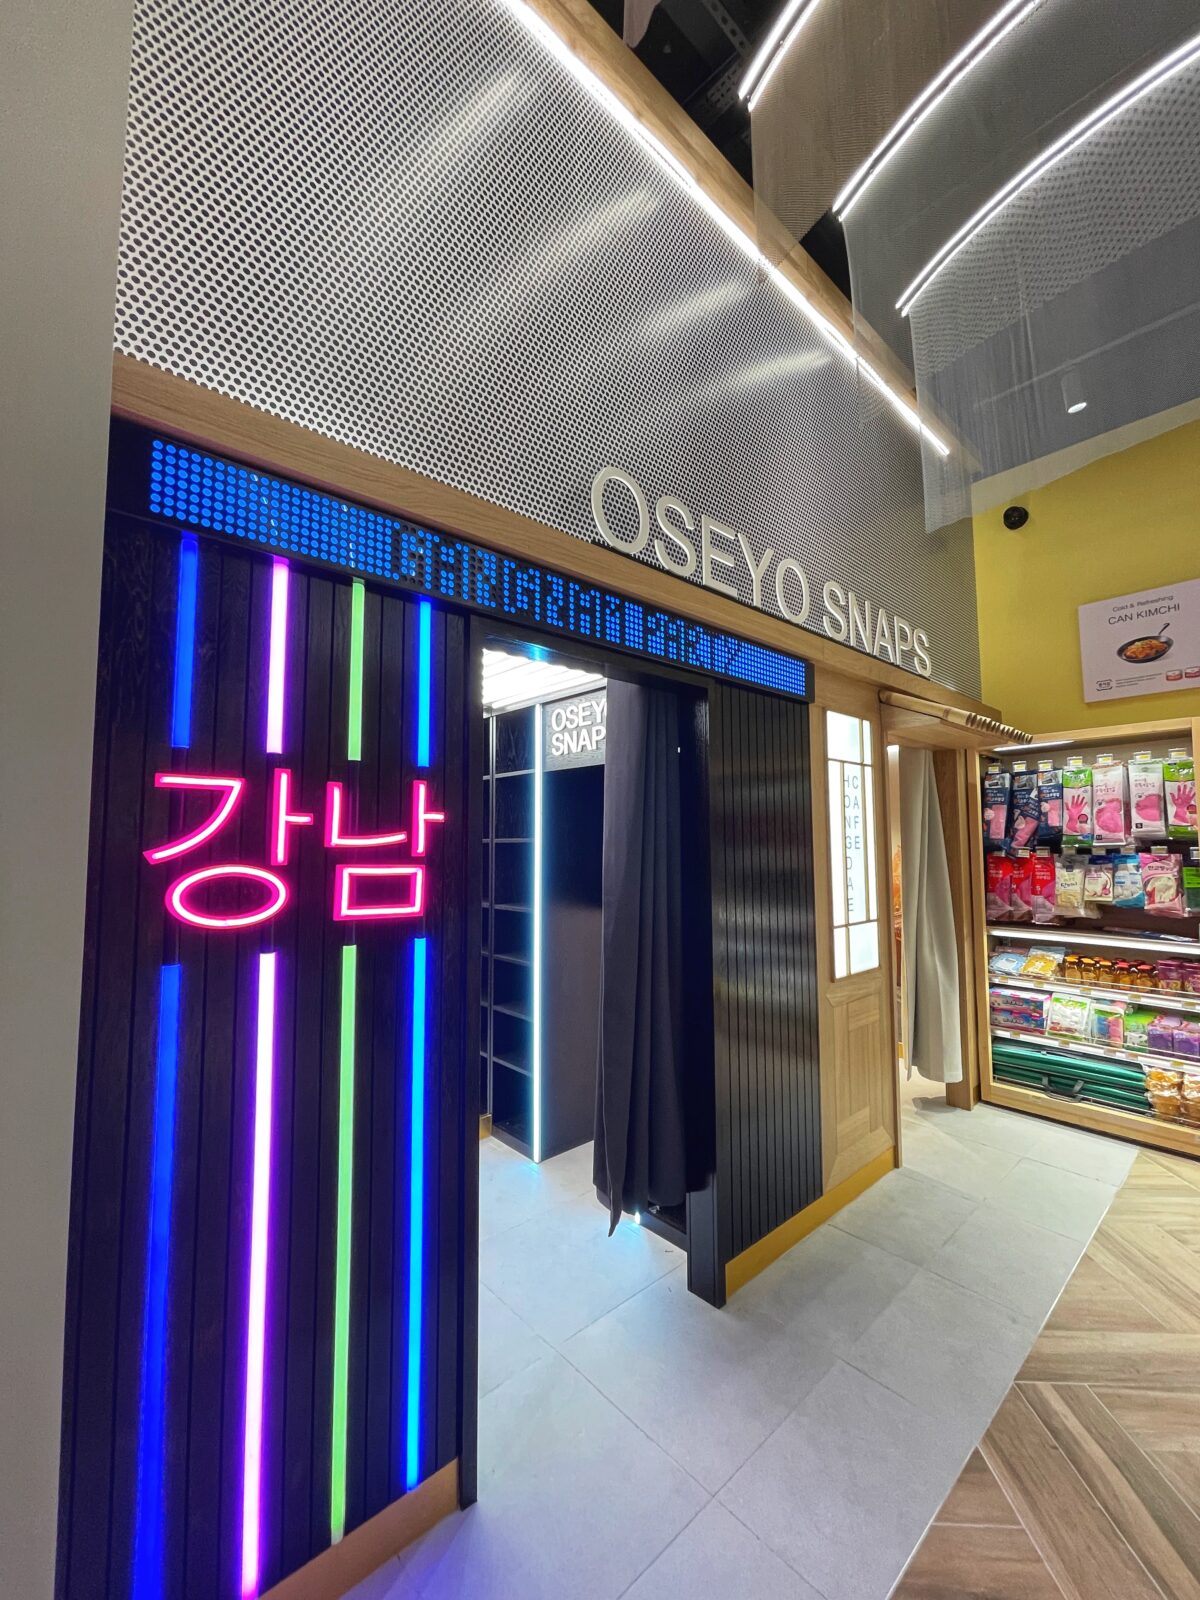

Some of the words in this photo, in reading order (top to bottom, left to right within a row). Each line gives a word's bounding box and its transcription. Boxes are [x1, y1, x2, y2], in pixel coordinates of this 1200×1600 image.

[591, 466, 810, 625] OSEYO
[823, 581, 932, 677] SNAPS
[1112, 604, 1128, 613] Cold
[1108, 613, 1133, 625] CAN
[1136, 603, 1180, 619] KIMCHI
[143, 768, 445, 930] 강남
[851, 775, 861, 850] CAFE
